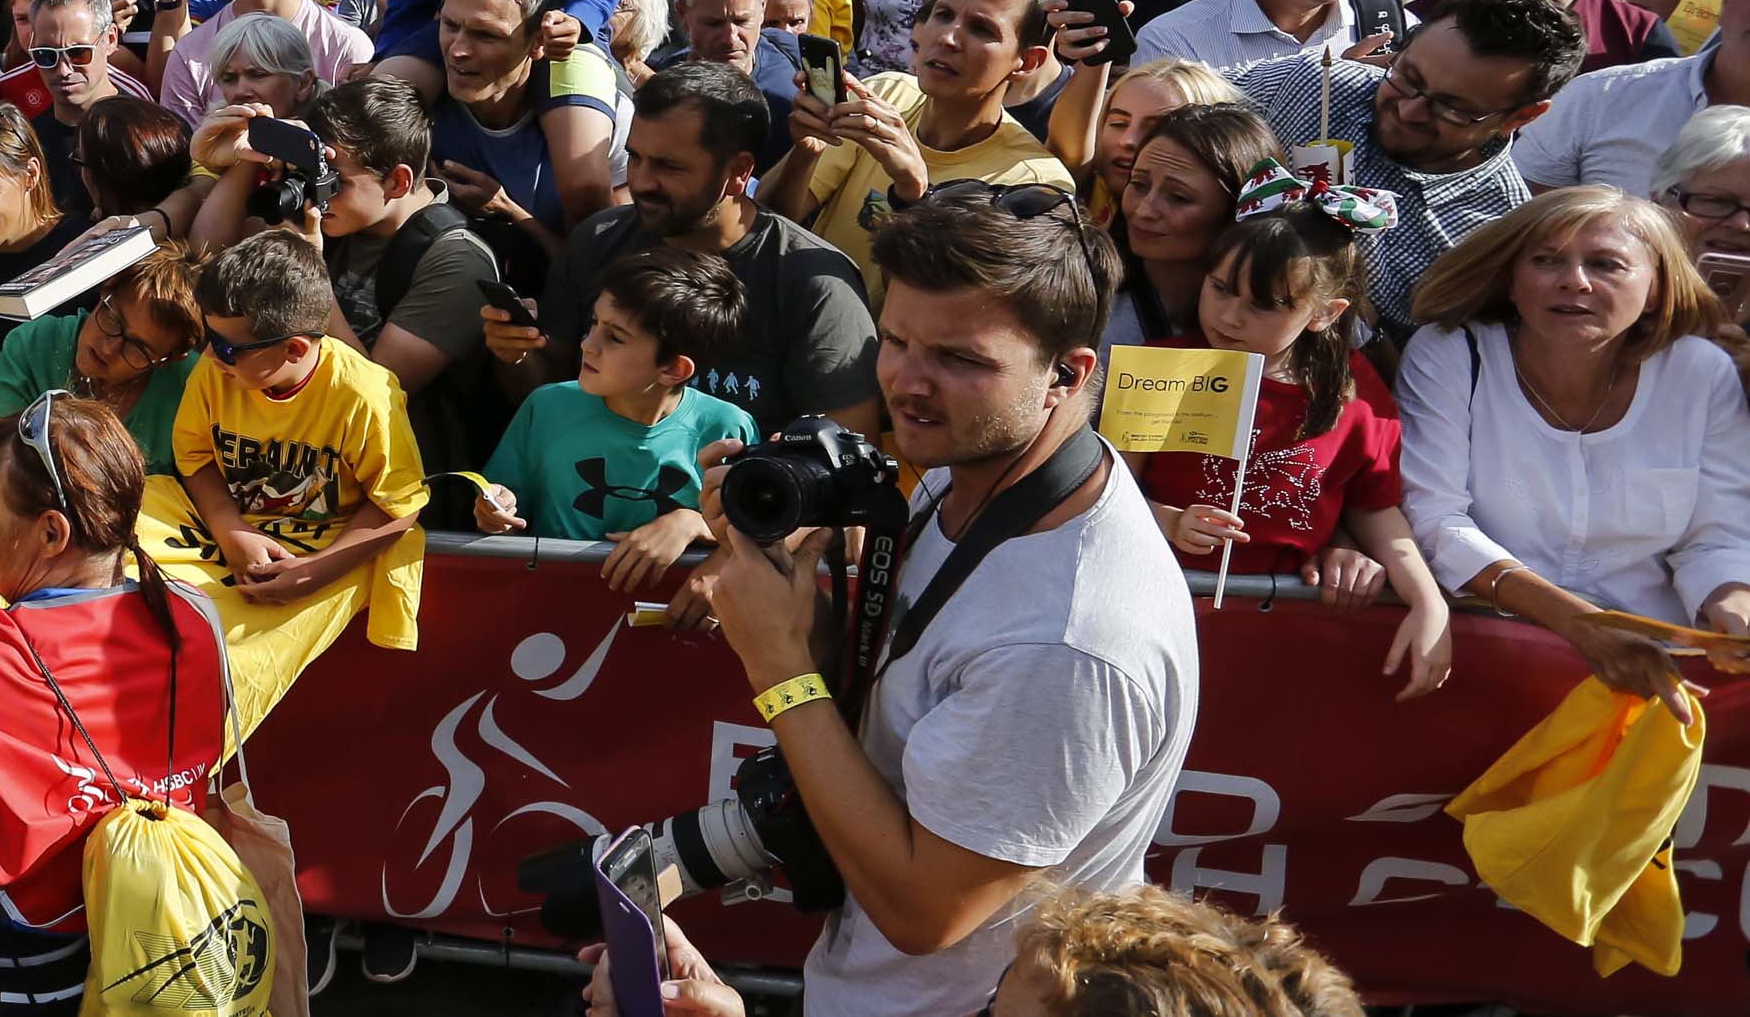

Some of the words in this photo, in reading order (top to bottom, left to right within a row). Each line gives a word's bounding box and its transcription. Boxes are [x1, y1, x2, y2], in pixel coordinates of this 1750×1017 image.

[1118, 372, 1186, 393] Dream
[1192, 375, 1229, 393] BIG
[784, 434, 812, 442] Canon
[870, 536, 893, 587] EOS
[865, 592, 884, 617] 5D
[153, 770, 194, 794] HSBC
